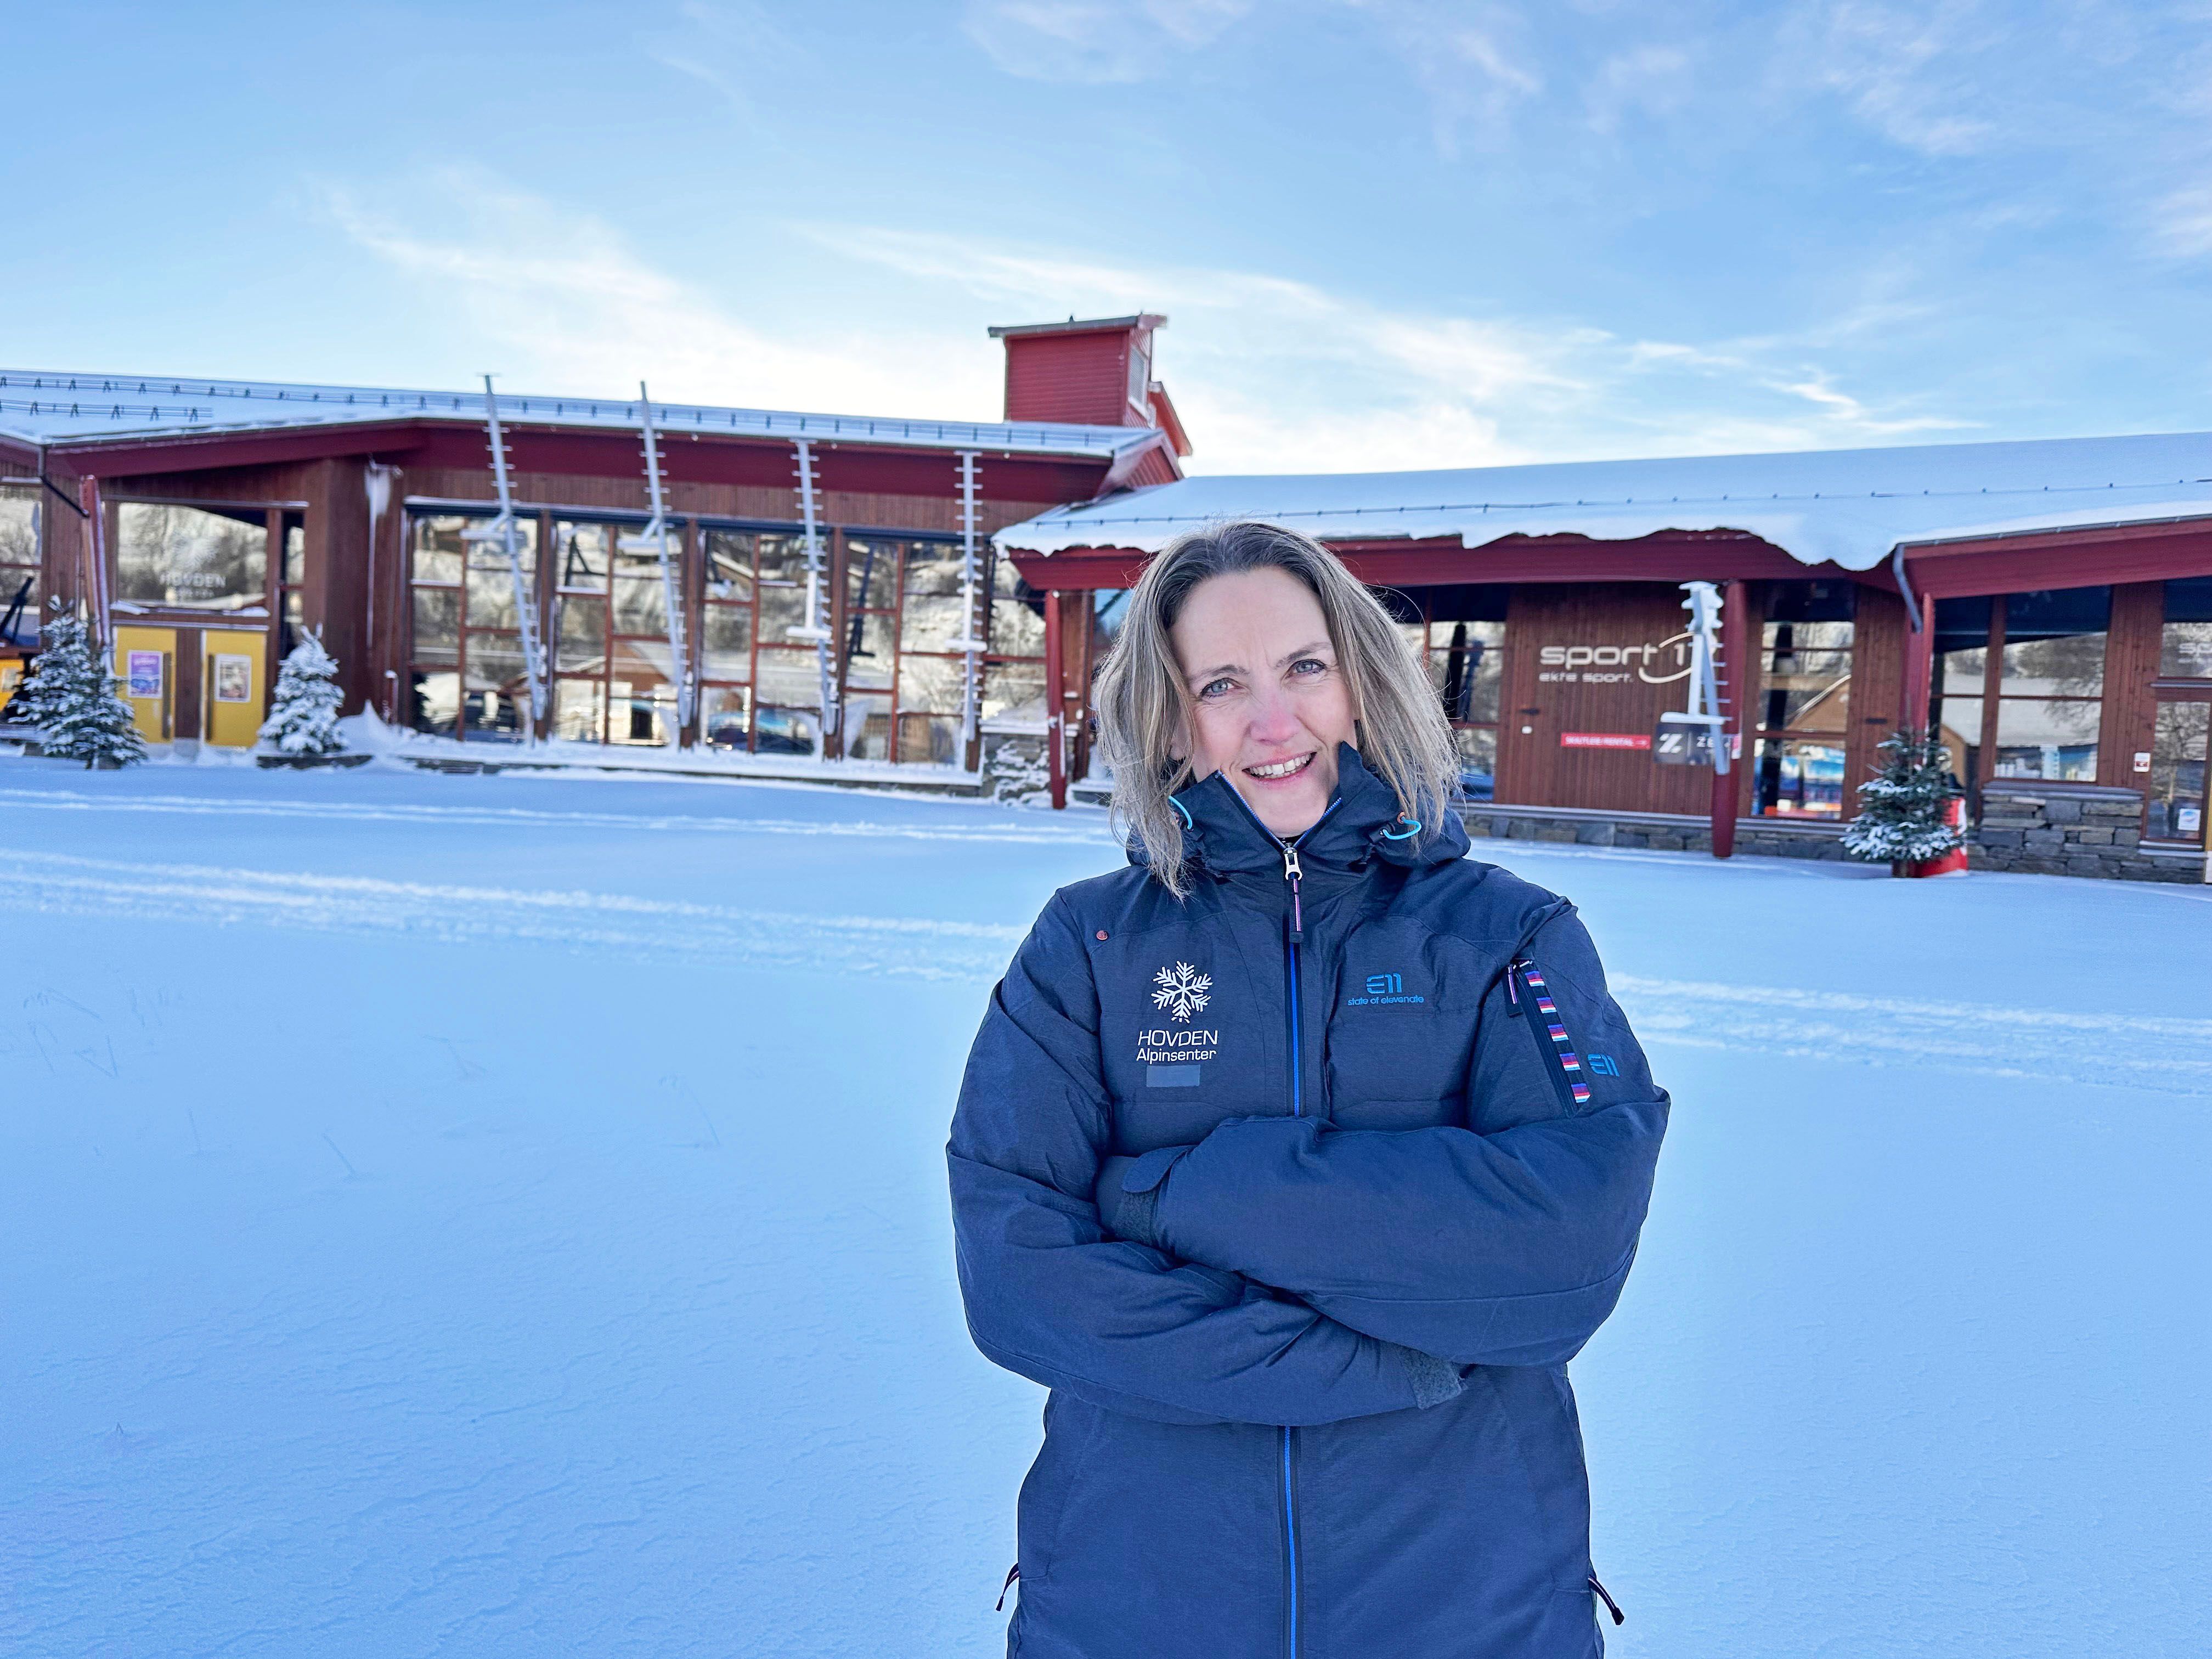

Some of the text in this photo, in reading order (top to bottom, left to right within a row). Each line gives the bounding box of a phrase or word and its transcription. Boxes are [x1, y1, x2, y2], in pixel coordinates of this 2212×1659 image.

[160, 572, 226, 588] HOVDEN
[1540, 643, 1658, 670] sport
[1539, 671, 1578, 683] ekte
[1347, 994, 1425, 1006] state of elevenate
[1137, 1029, 1218, 1047] HOVDEN
[1136, 1048, 1217, 1065] Alpinsenter
